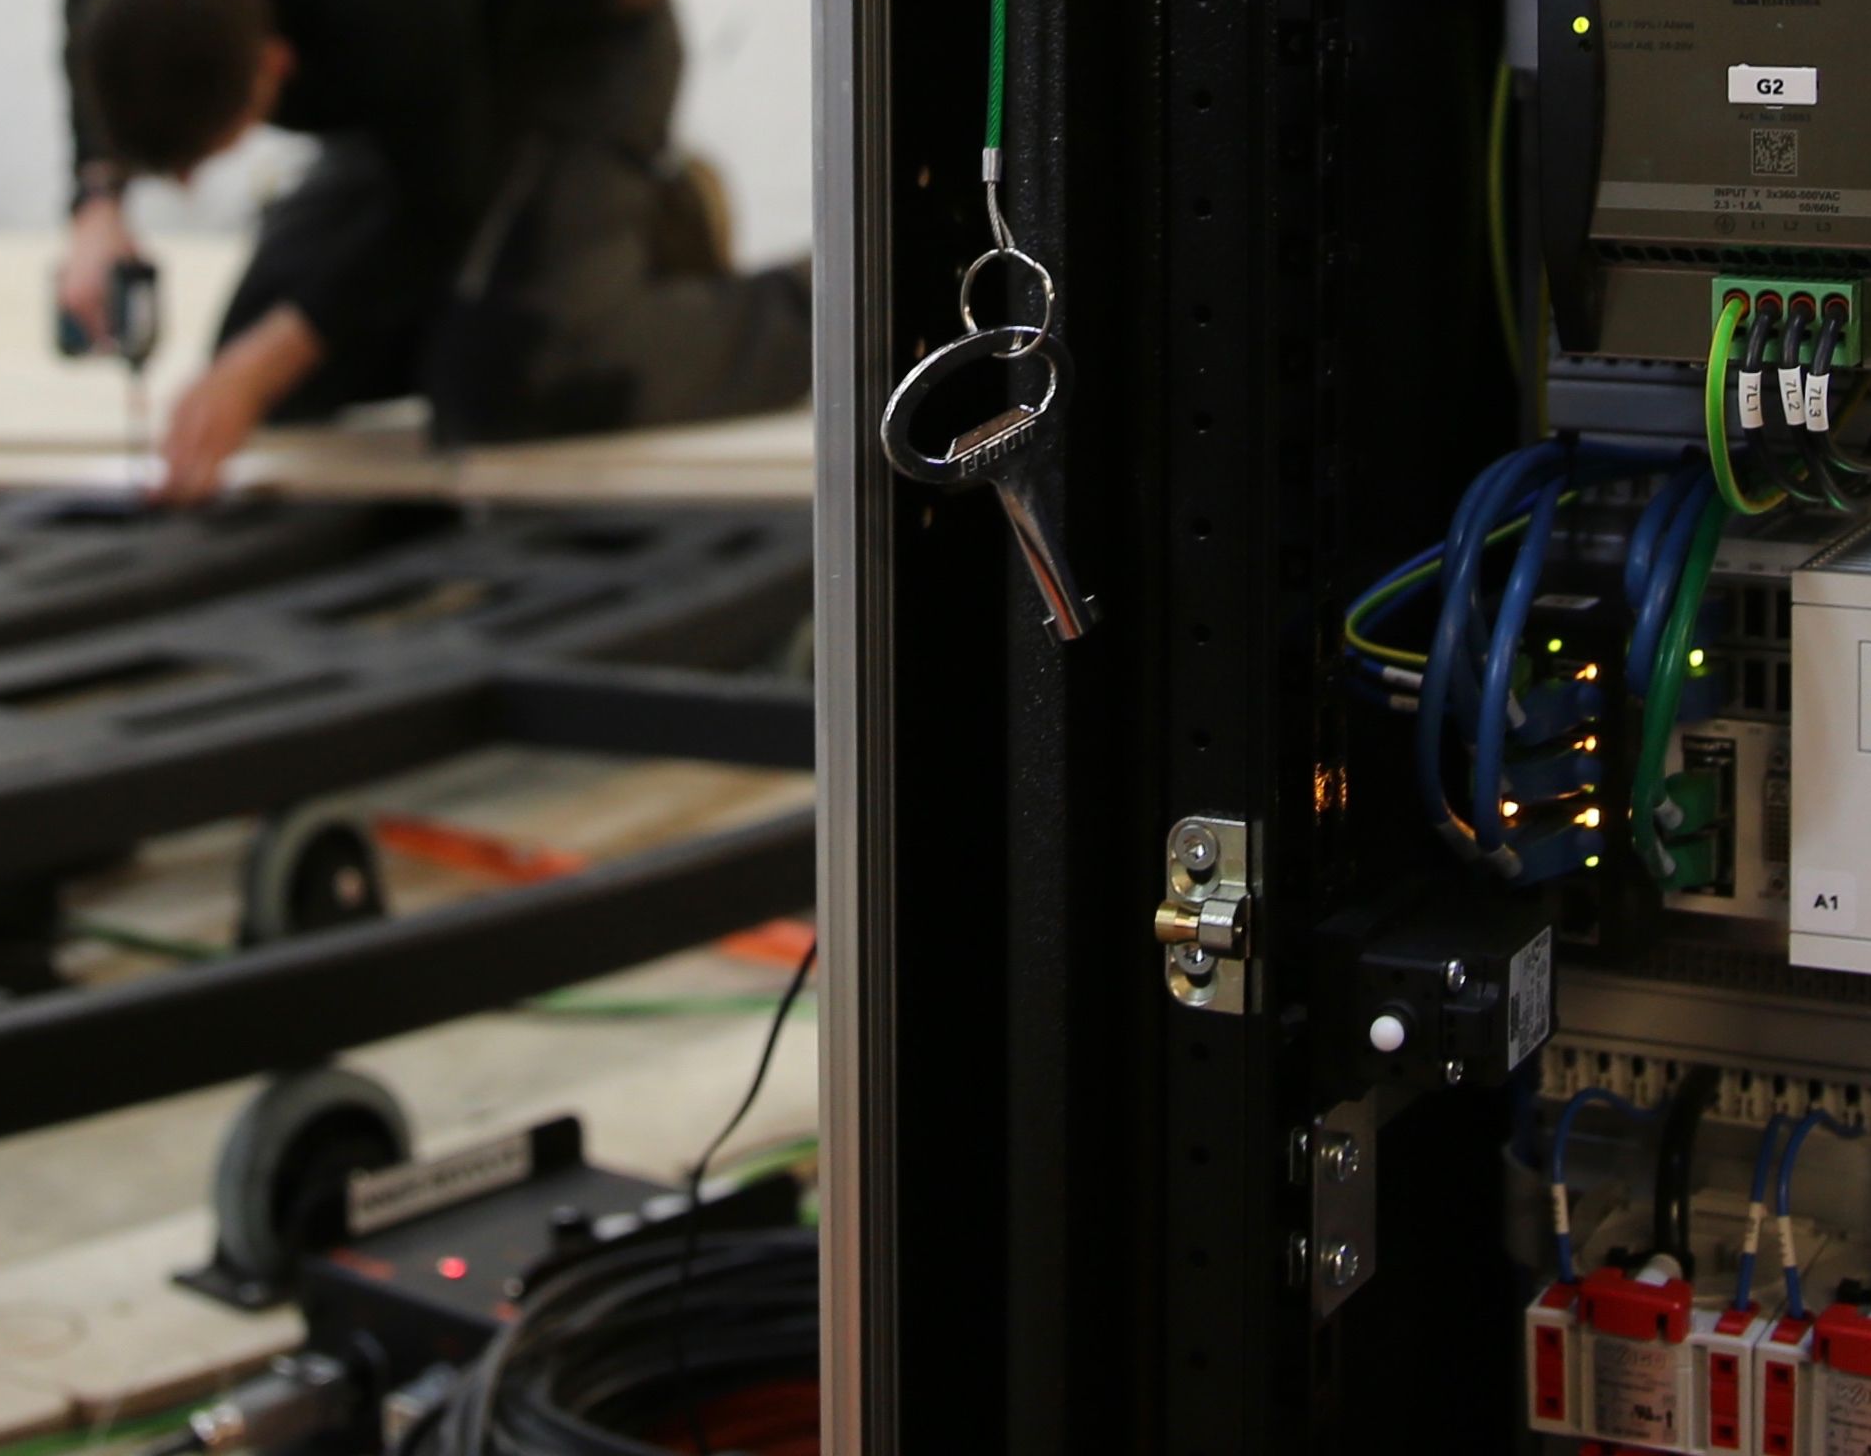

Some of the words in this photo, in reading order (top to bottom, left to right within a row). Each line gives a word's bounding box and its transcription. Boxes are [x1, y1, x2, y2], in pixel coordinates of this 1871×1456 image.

[1756, 79, 1784, 96] G2
[1714, 188, 1747, 198] INPUT
[1746, 384, 1759, 412] 7L1
[1785, 379, 1801, 412] 7L2
[1809, 386, 1823, 418] 7L3
[1814, 895, 1839, 912] A1
